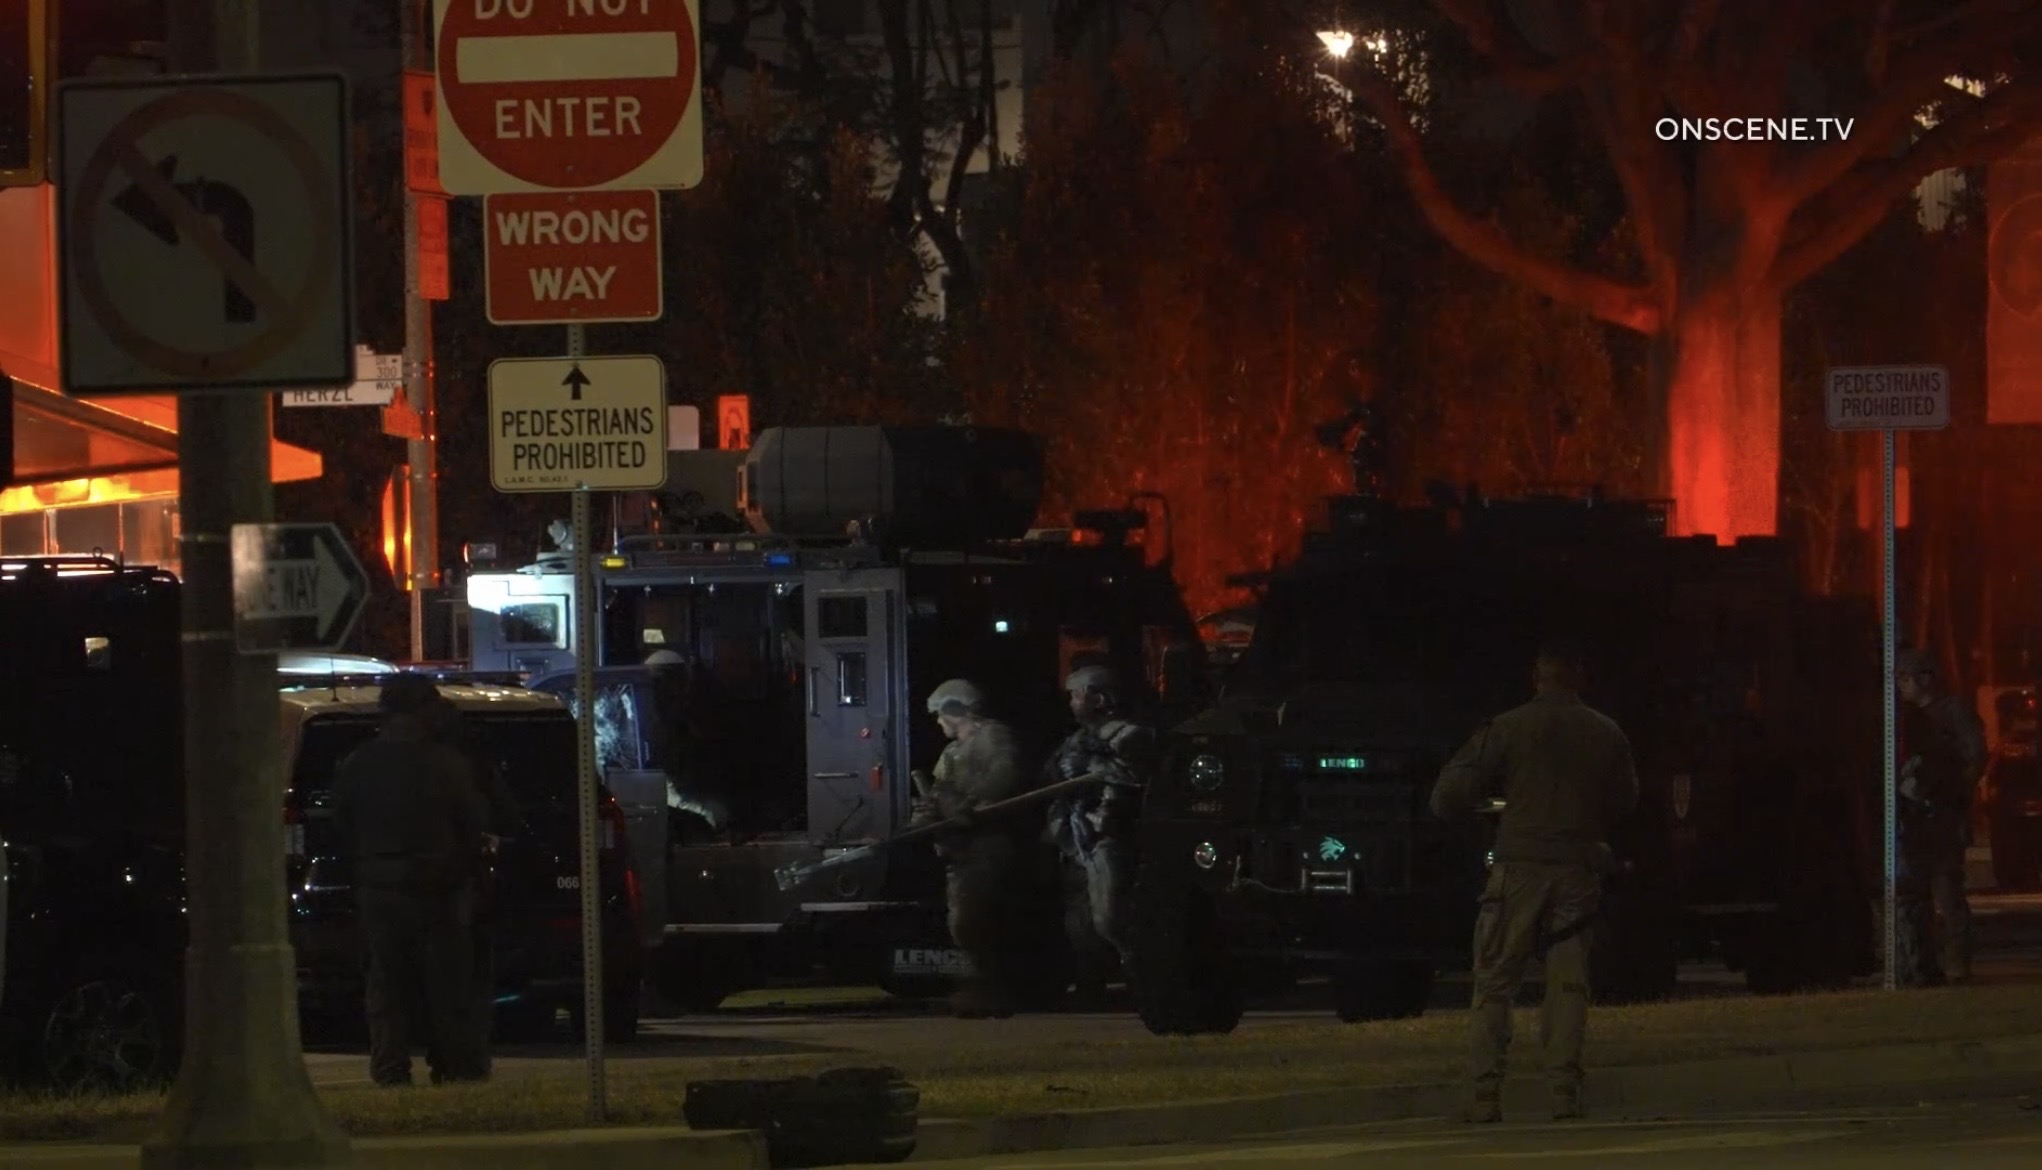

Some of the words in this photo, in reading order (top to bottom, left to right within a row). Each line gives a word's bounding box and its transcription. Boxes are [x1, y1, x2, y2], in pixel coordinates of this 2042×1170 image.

[495, 97, 642, 139] ENTER
[496, 208, 649, 246] WRONG
[529, 265, 617, 301] WAY
[1833, 372, 1940, 394] PEDESTRIANS
[1841, 396, 1935, 417] PROHIBITED
[502, 407, 654, 437] PEDESTRIANS
[514, 441, 646, 470] PROHIBITED
[284, 566, 319, 609] WAY
[1320, 757, 1366, 768] LENCO
